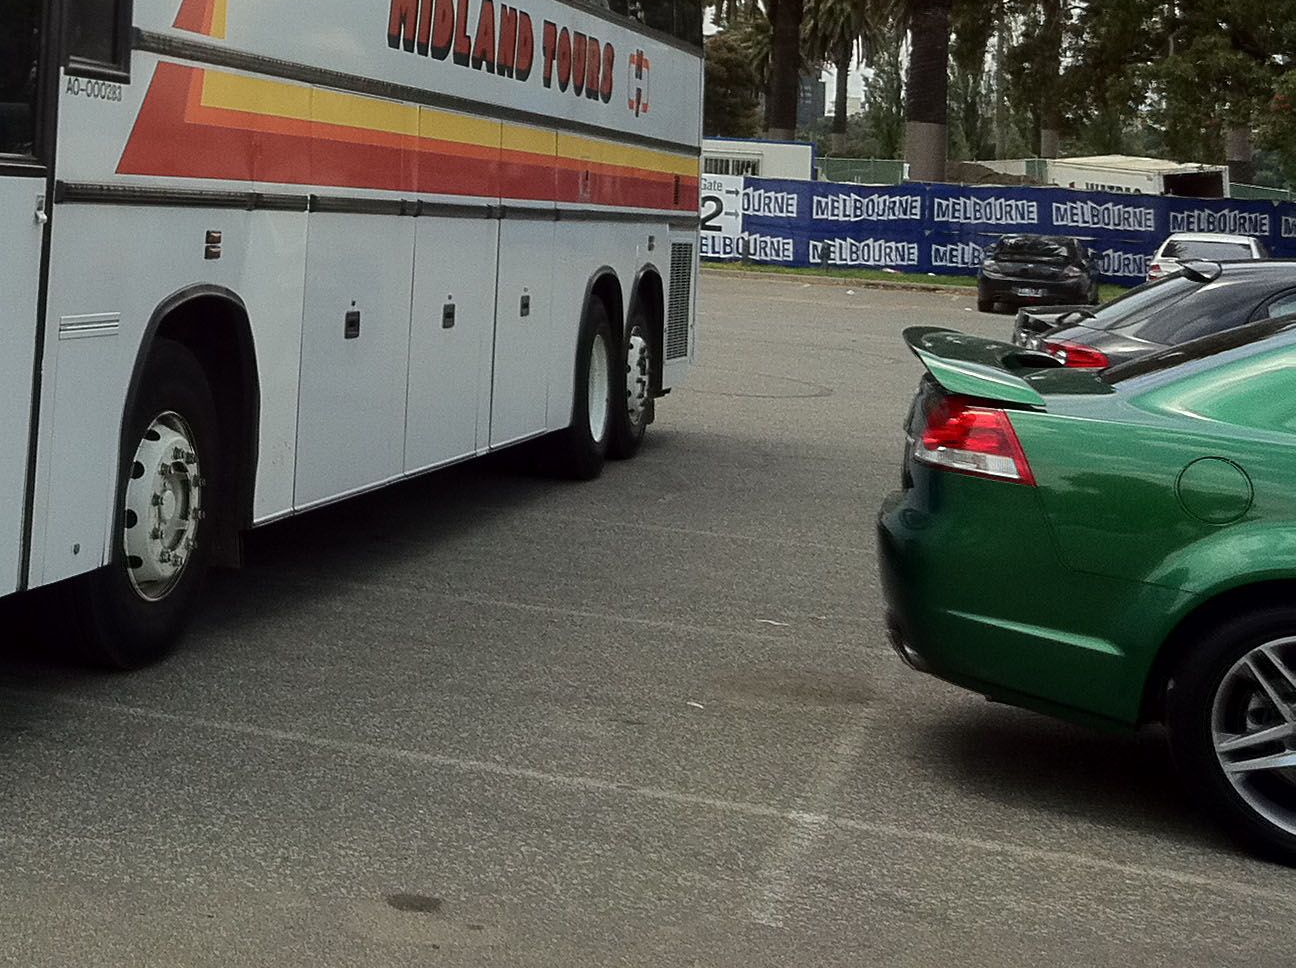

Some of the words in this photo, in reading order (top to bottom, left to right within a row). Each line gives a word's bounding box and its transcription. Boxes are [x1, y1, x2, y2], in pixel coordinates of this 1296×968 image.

[543, 19, 615, 104] TOURS
[700, 195, 724, 232] 2
[814, 194, 920, 220] MELBOURNE
[935, 197, 1037, 223] MELBOURNE
[1054, 204, 1153, 230] MELBOURNE
[1171, 211, 1269, 234] MELBOURNE
[700, 234, 793, 260] ELBOURNE
